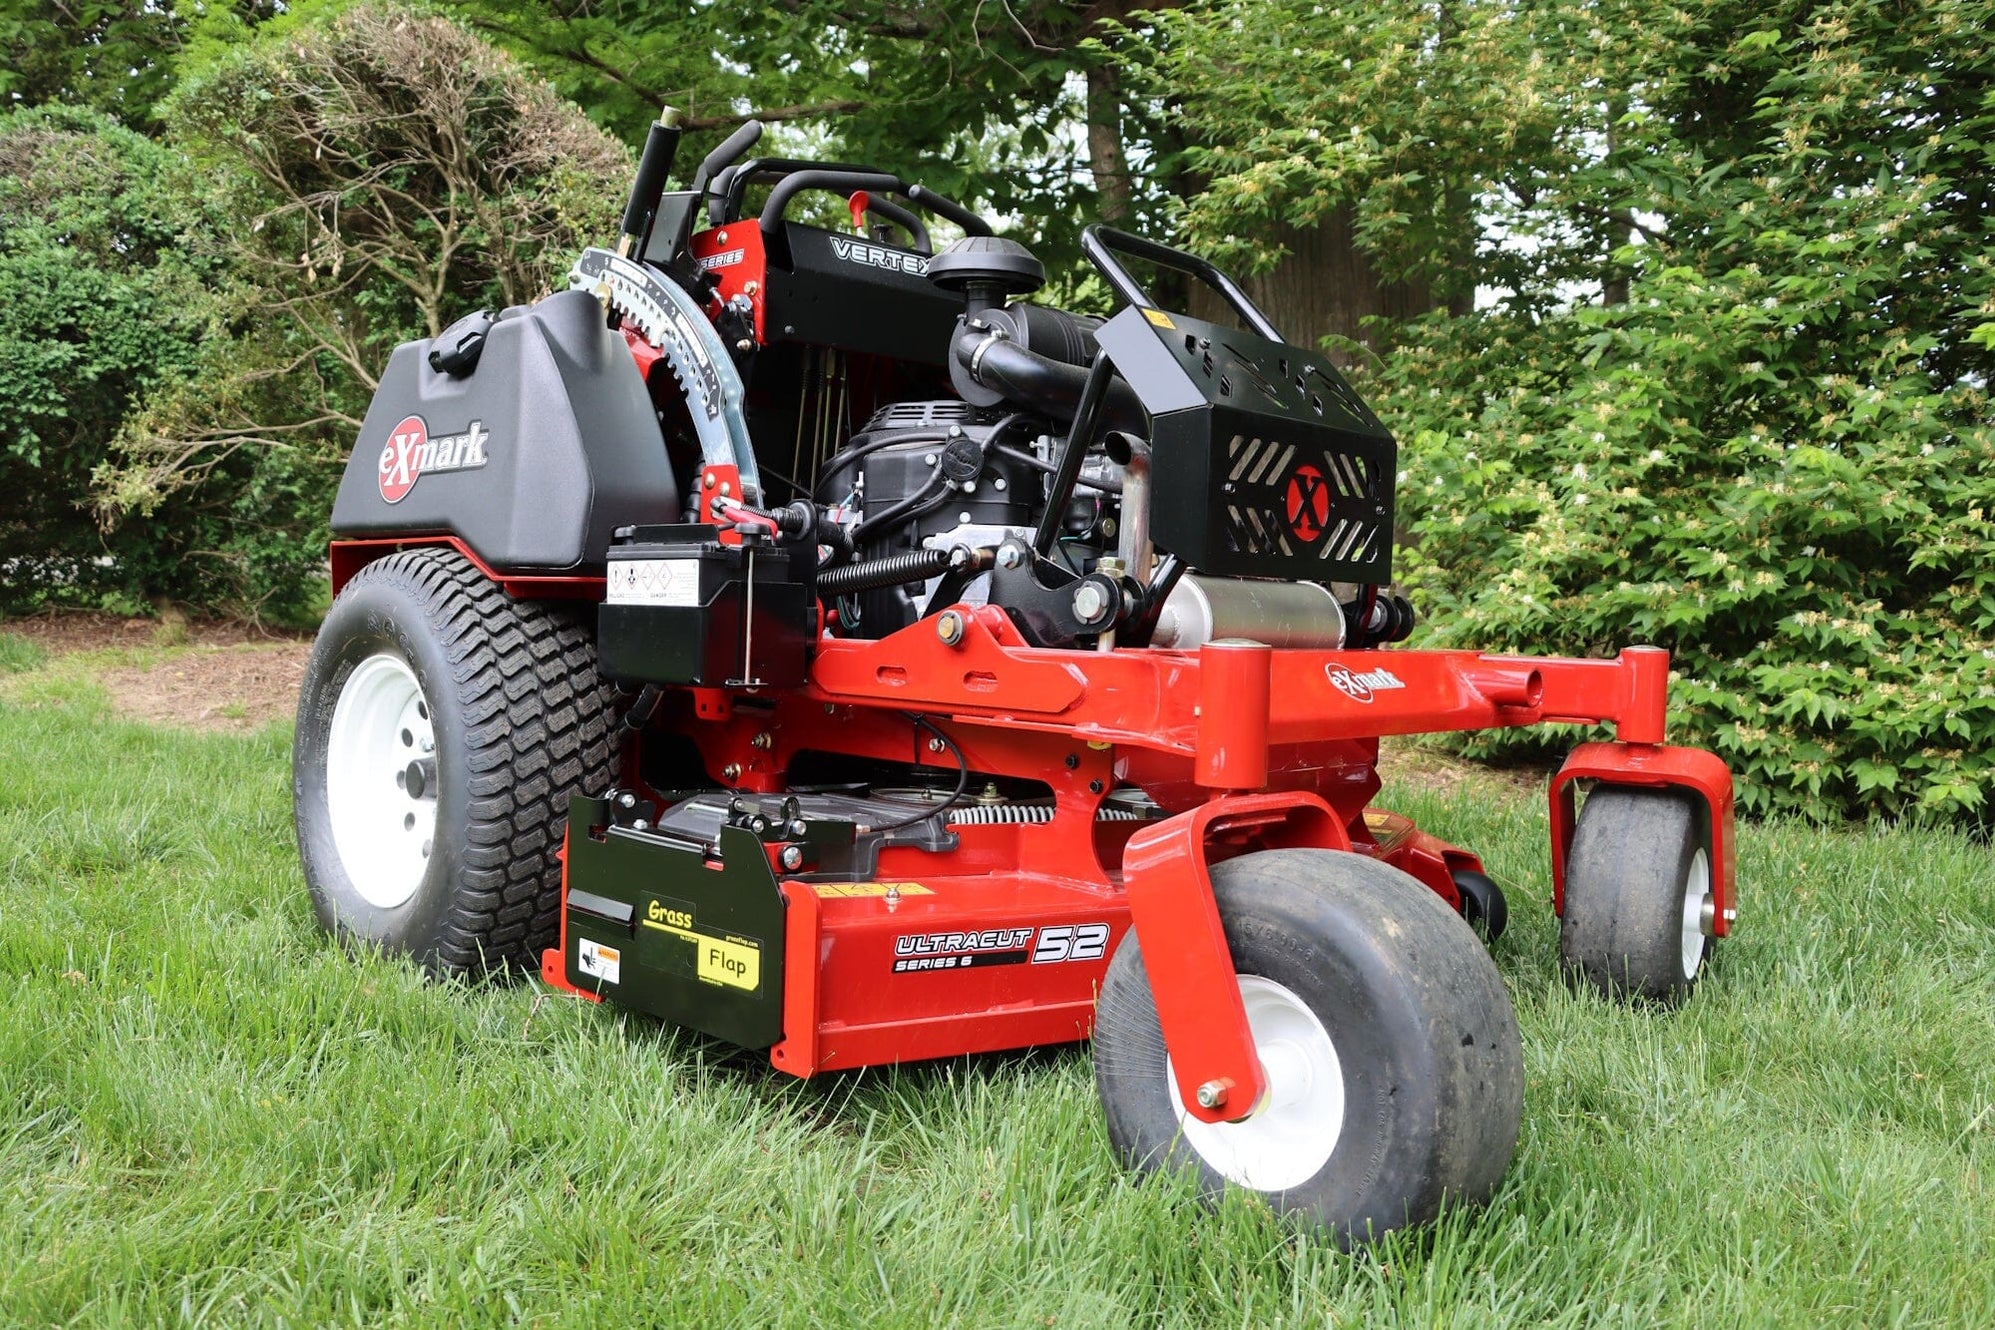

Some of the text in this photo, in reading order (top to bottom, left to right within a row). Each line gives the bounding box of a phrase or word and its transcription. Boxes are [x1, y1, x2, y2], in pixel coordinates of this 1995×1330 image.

[379, 421, 489, 487] eXmark
[1289, 475, 1327, 529] X
[648, 899, 693, 929] Grass
[895, 924, 1109, 962] ULTRACUT 52
[710, 949, 746, 979] Flap
[895, 956, 972, 972] SERIES 6
